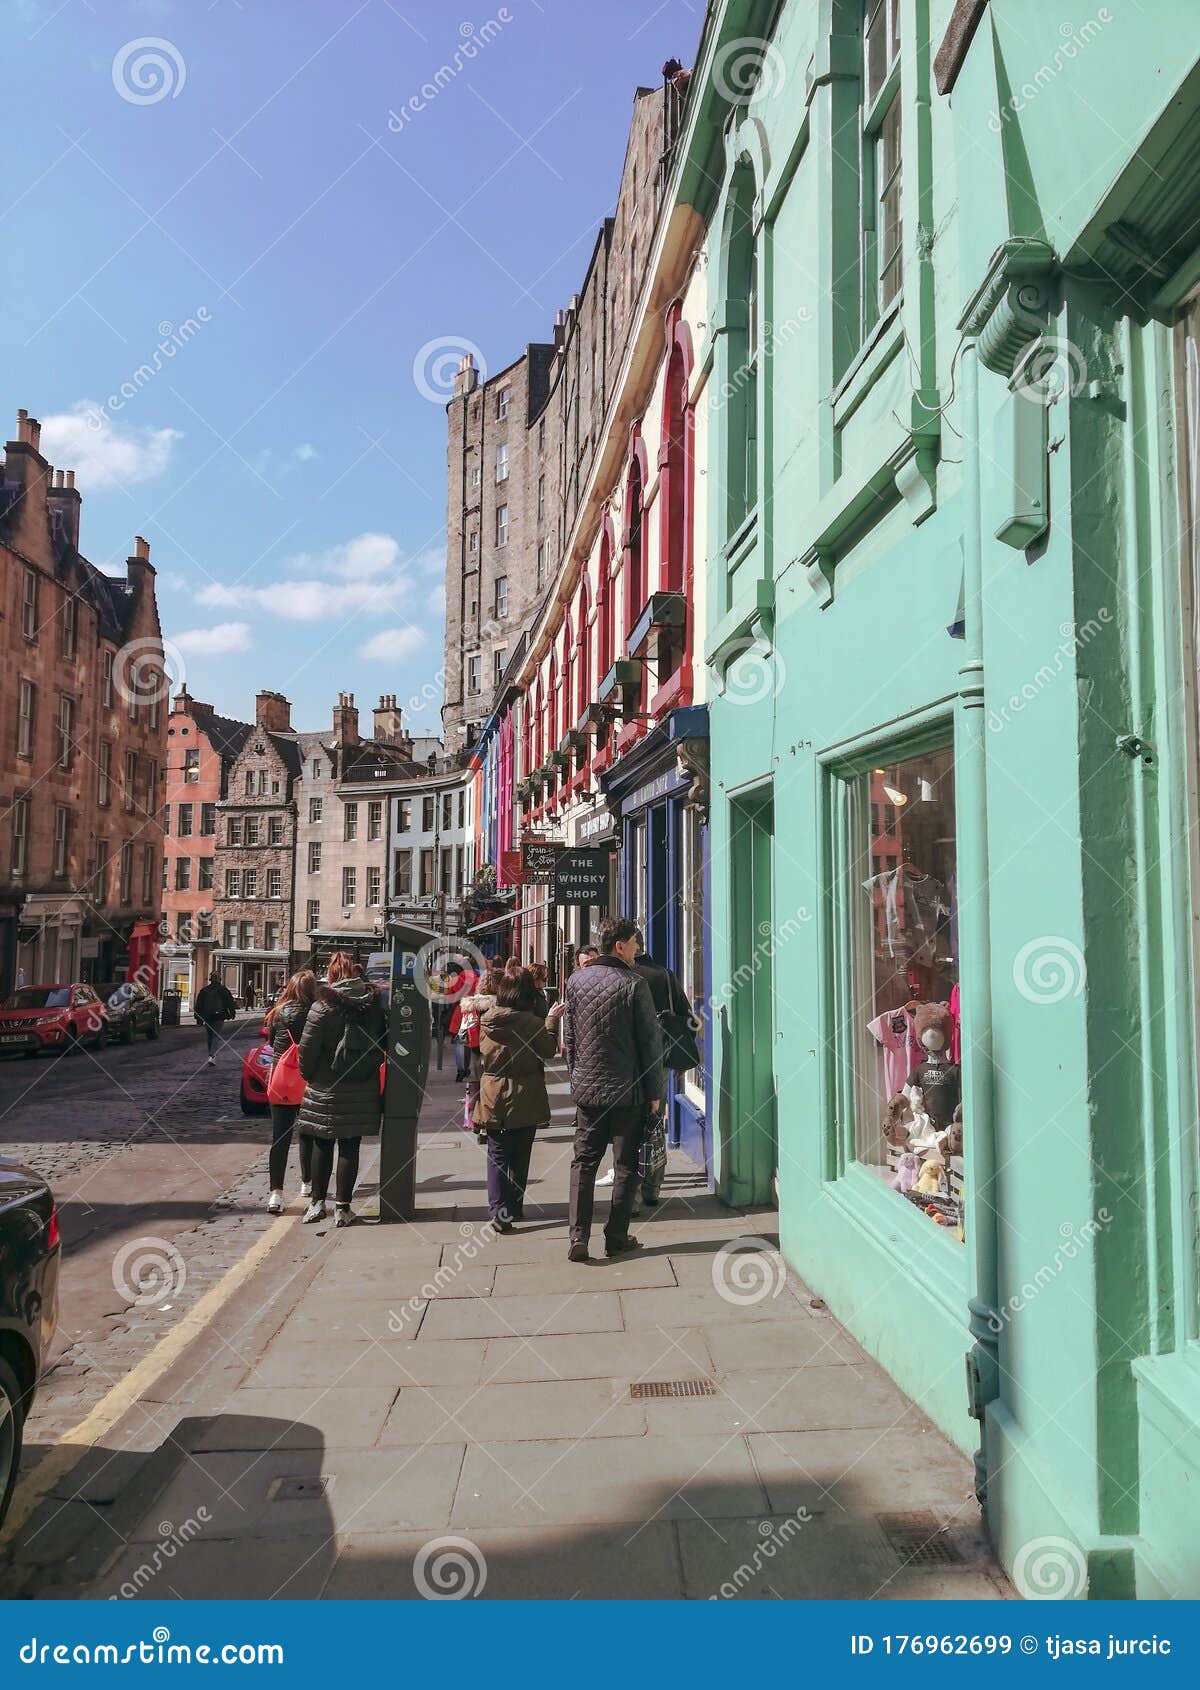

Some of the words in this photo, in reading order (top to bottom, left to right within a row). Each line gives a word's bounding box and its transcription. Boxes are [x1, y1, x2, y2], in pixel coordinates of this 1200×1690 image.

[570, 859, 593, 867] THE
[559, 875, 606, 883] WHISKY
[566, 890, 598, 898] SHOP
